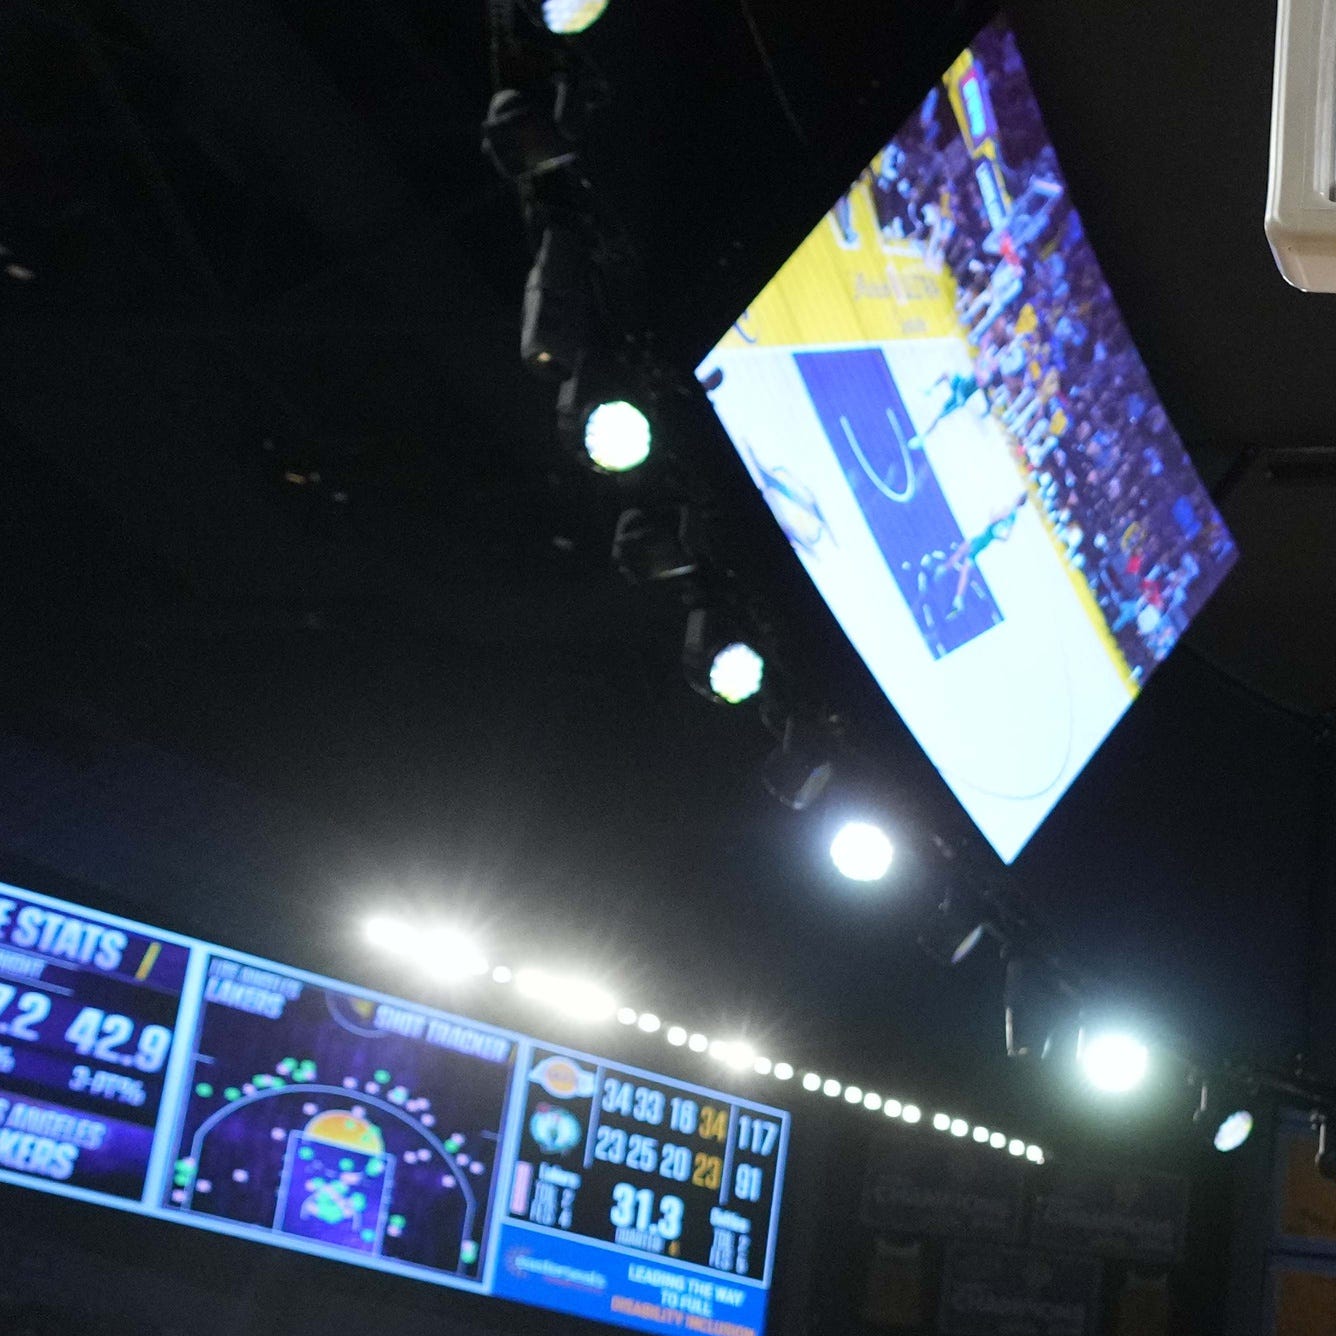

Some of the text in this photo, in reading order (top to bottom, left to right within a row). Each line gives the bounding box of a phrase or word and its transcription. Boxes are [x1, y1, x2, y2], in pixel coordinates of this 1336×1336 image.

[11, 906, 129, 972] STATS
[65, 1006, 172, 1073] 42.9
[737, 1114, 780, 1156] 117
[659, 1142, 693, 1182] 20
[735, 1162, 763, 1202] 91
[610, 1182, 685, 1240] 31.3
